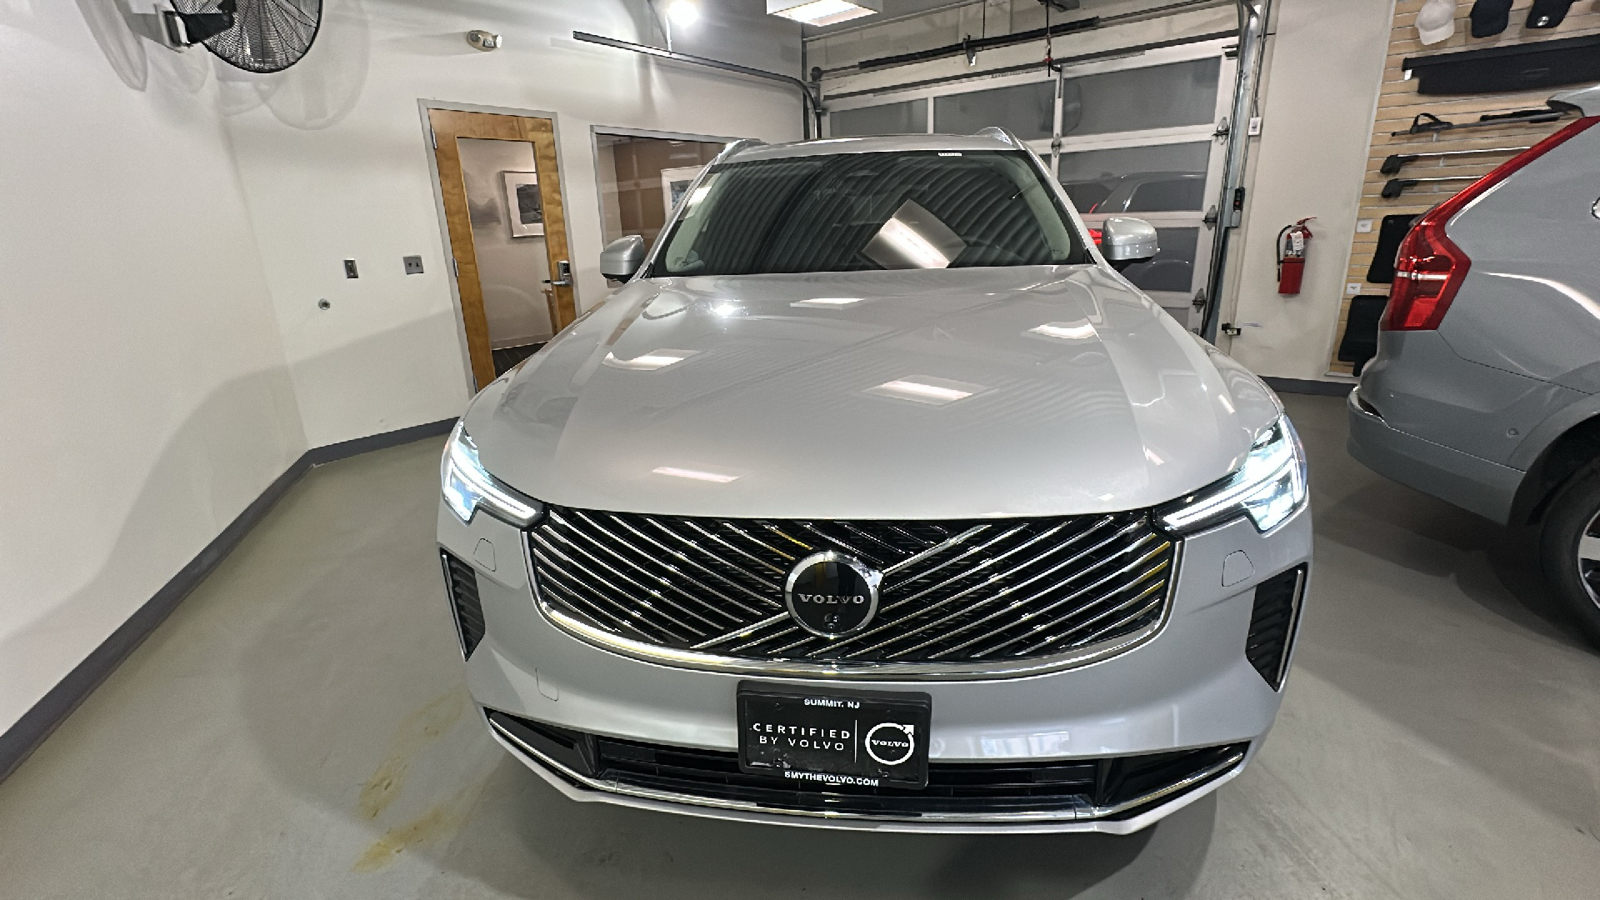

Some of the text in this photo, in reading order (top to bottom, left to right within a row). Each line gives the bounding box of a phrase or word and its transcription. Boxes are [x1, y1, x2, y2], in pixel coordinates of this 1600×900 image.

[798, 593, 864, 604] VOLVO
[847, 701, 860, 709] NJ
[752, 723, 850, 739] CERTIFIED
[759, 735, 844, 751] BY VOLVO
[871, 739, 908, 748] VOLVO
[784, 771, 879, 787] SMYTHEVOLVO.COM
